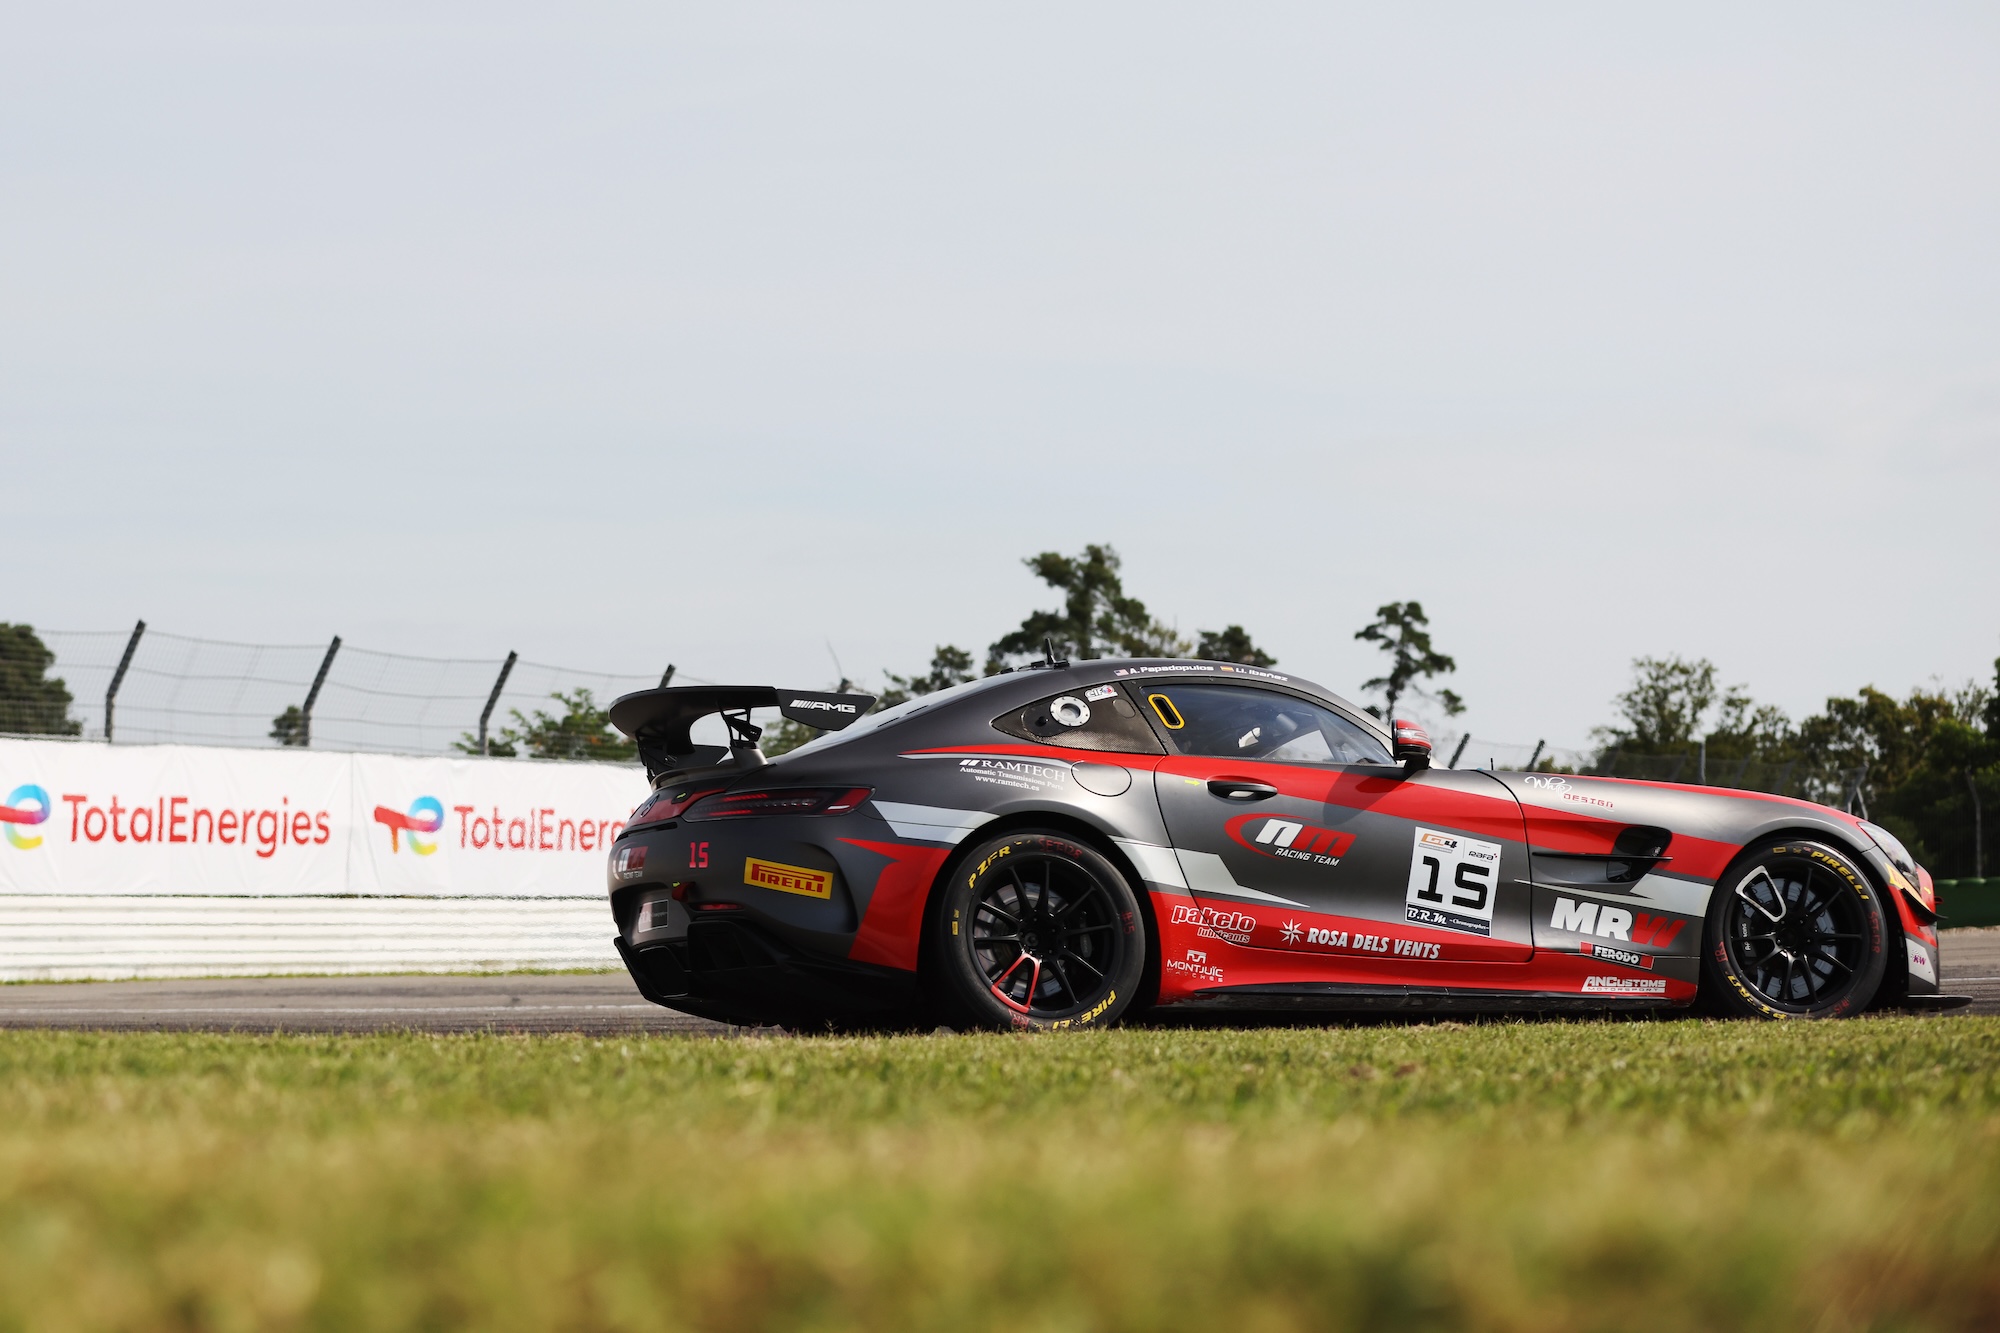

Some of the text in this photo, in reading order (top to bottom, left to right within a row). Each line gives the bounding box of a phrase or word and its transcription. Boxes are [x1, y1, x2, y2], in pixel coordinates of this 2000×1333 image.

[811, 701, 856, 714] AMG
[960, 766, 996, 776] Automatic
[997, 771, 1045, 786] Transmissions
[975, 775, 1040, 792] www.ramtech.es
[981, 760, 1065, 782] RAMTECH
[62, 794, 330, 858] TotalEnergies
[454, 805, 629, 852] TotalEner
[689, 841, 709, 868] 15
[1275, 848, 1340, 867] RACING TEAM
[751, 863, 825, 893] PIRELLI
[1417, 855, 1490, 910] 15
[1811, 850, 1870, 901] PIRELLI
[1171, 905, 1257, 933] pakelo
[1550, 896, 1688, 949] MRW
[1197, 927, 1251, 944] lubricants
[1306, 927, 1442, 960] ROSA DELS VENTS
[1594, 946, 1640, 964] FERODO
